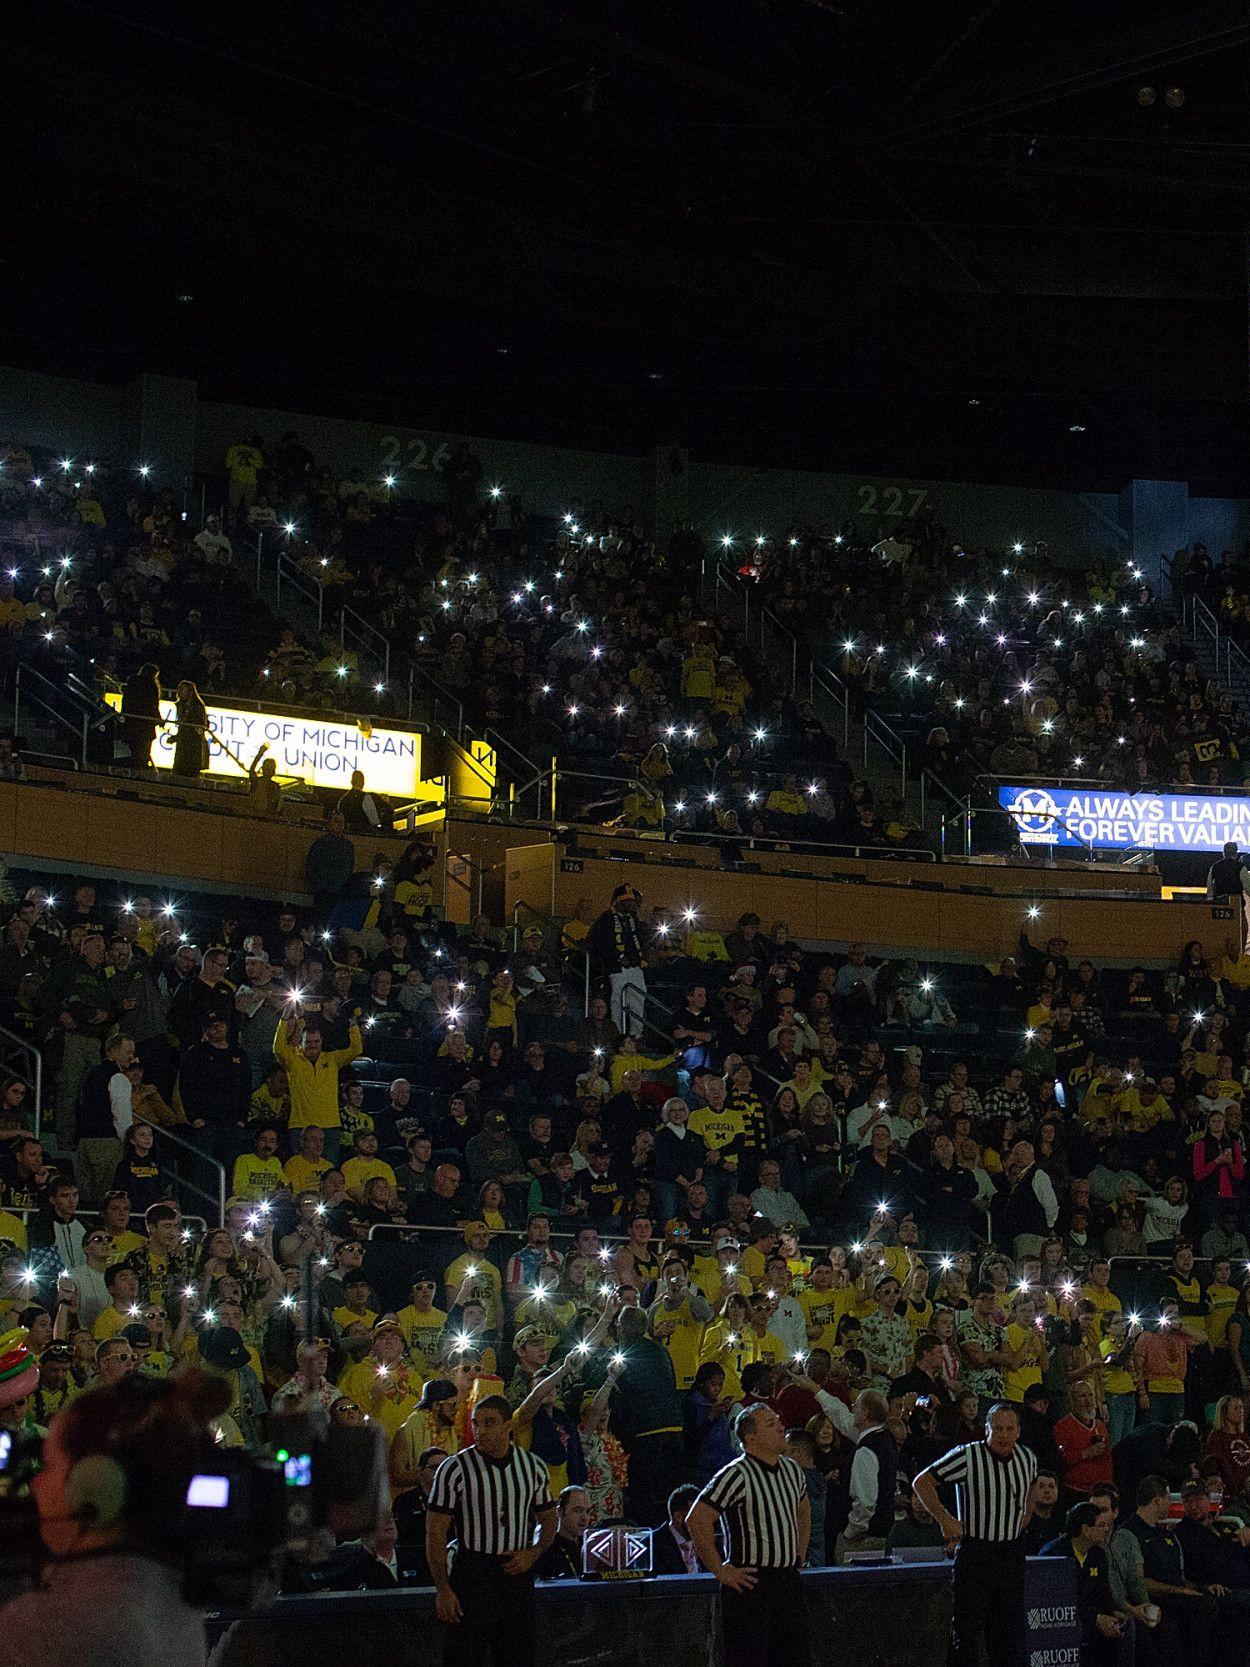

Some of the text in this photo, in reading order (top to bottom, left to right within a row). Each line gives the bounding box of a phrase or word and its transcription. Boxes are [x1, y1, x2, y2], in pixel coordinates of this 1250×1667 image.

[857, 485, 927, 517] 227
[264, 722, 295, 742] OF
[303, 728, 415, 757] MICHIGAN
[284, 747, 359, 772] UNION
[1065, 796, 1165, 822] ALWAYS
[1066, 819, 1175, 844] FOREVER
[1040, 1606, 1077, 1622] RUOFF
[1043, 1647, 1080, 1663] RUOFF
